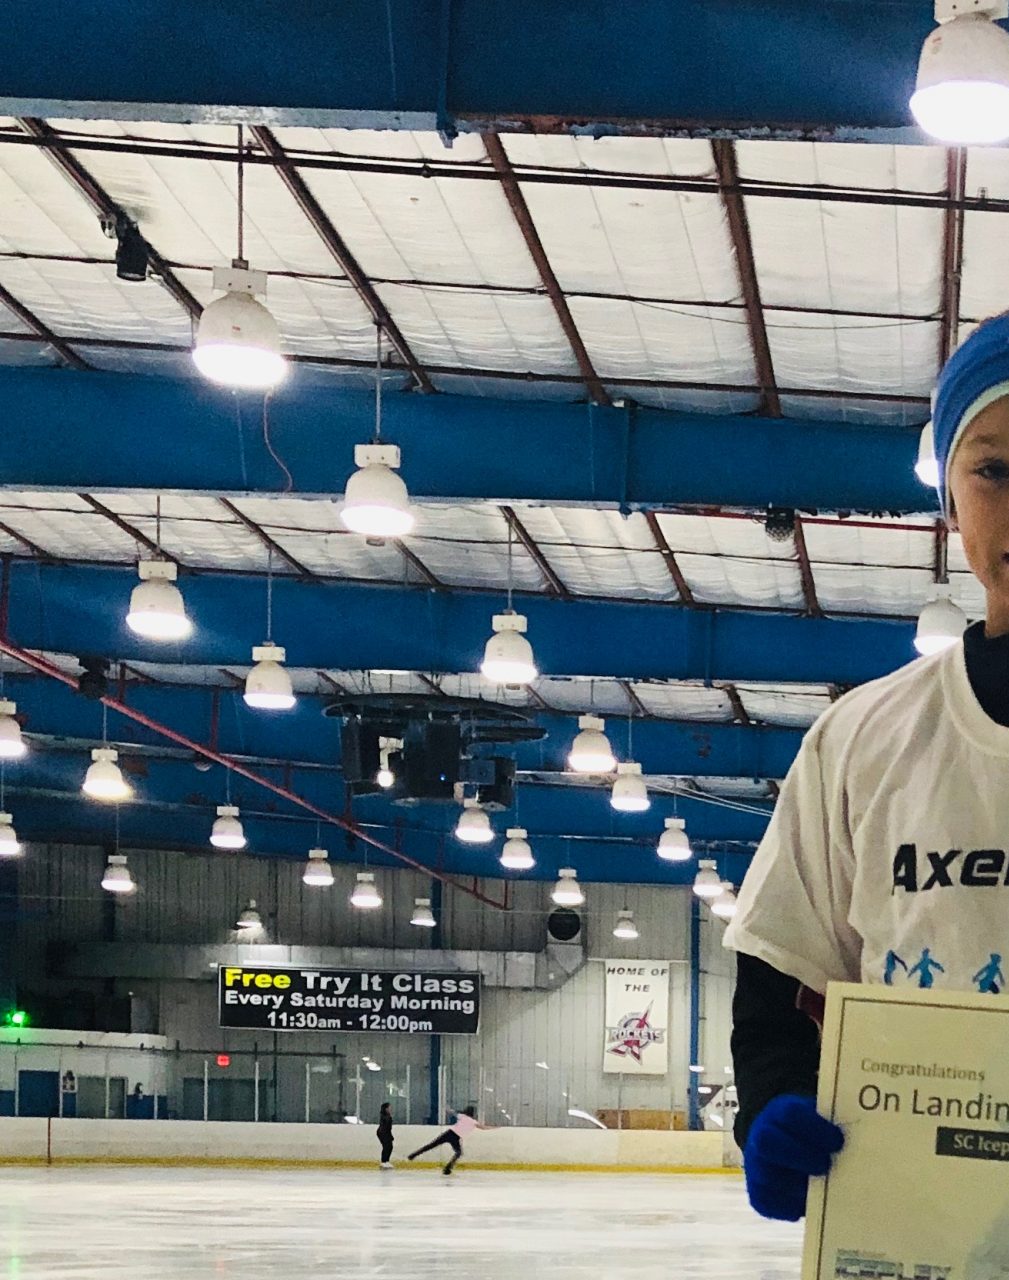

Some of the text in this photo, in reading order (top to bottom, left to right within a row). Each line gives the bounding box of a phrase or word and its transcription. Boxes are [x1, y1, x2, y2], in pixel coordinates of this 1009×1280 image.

[225, 968, 475, 995] Free Try It Class
[606, 967, 668, 977] HOME OF
[624, 984, 651, 993] THE
[225, 990, 475, 1015] Every Saturday Morning
[267, 1011, 341, 1029] 11:30am
[358, 1014, 433, 1034] 12:00pm
[860, 1058, 986, 1081] Congratulations
[858, 1084, 901, 1114] On
[953, 1133, 974, 1150] SC
